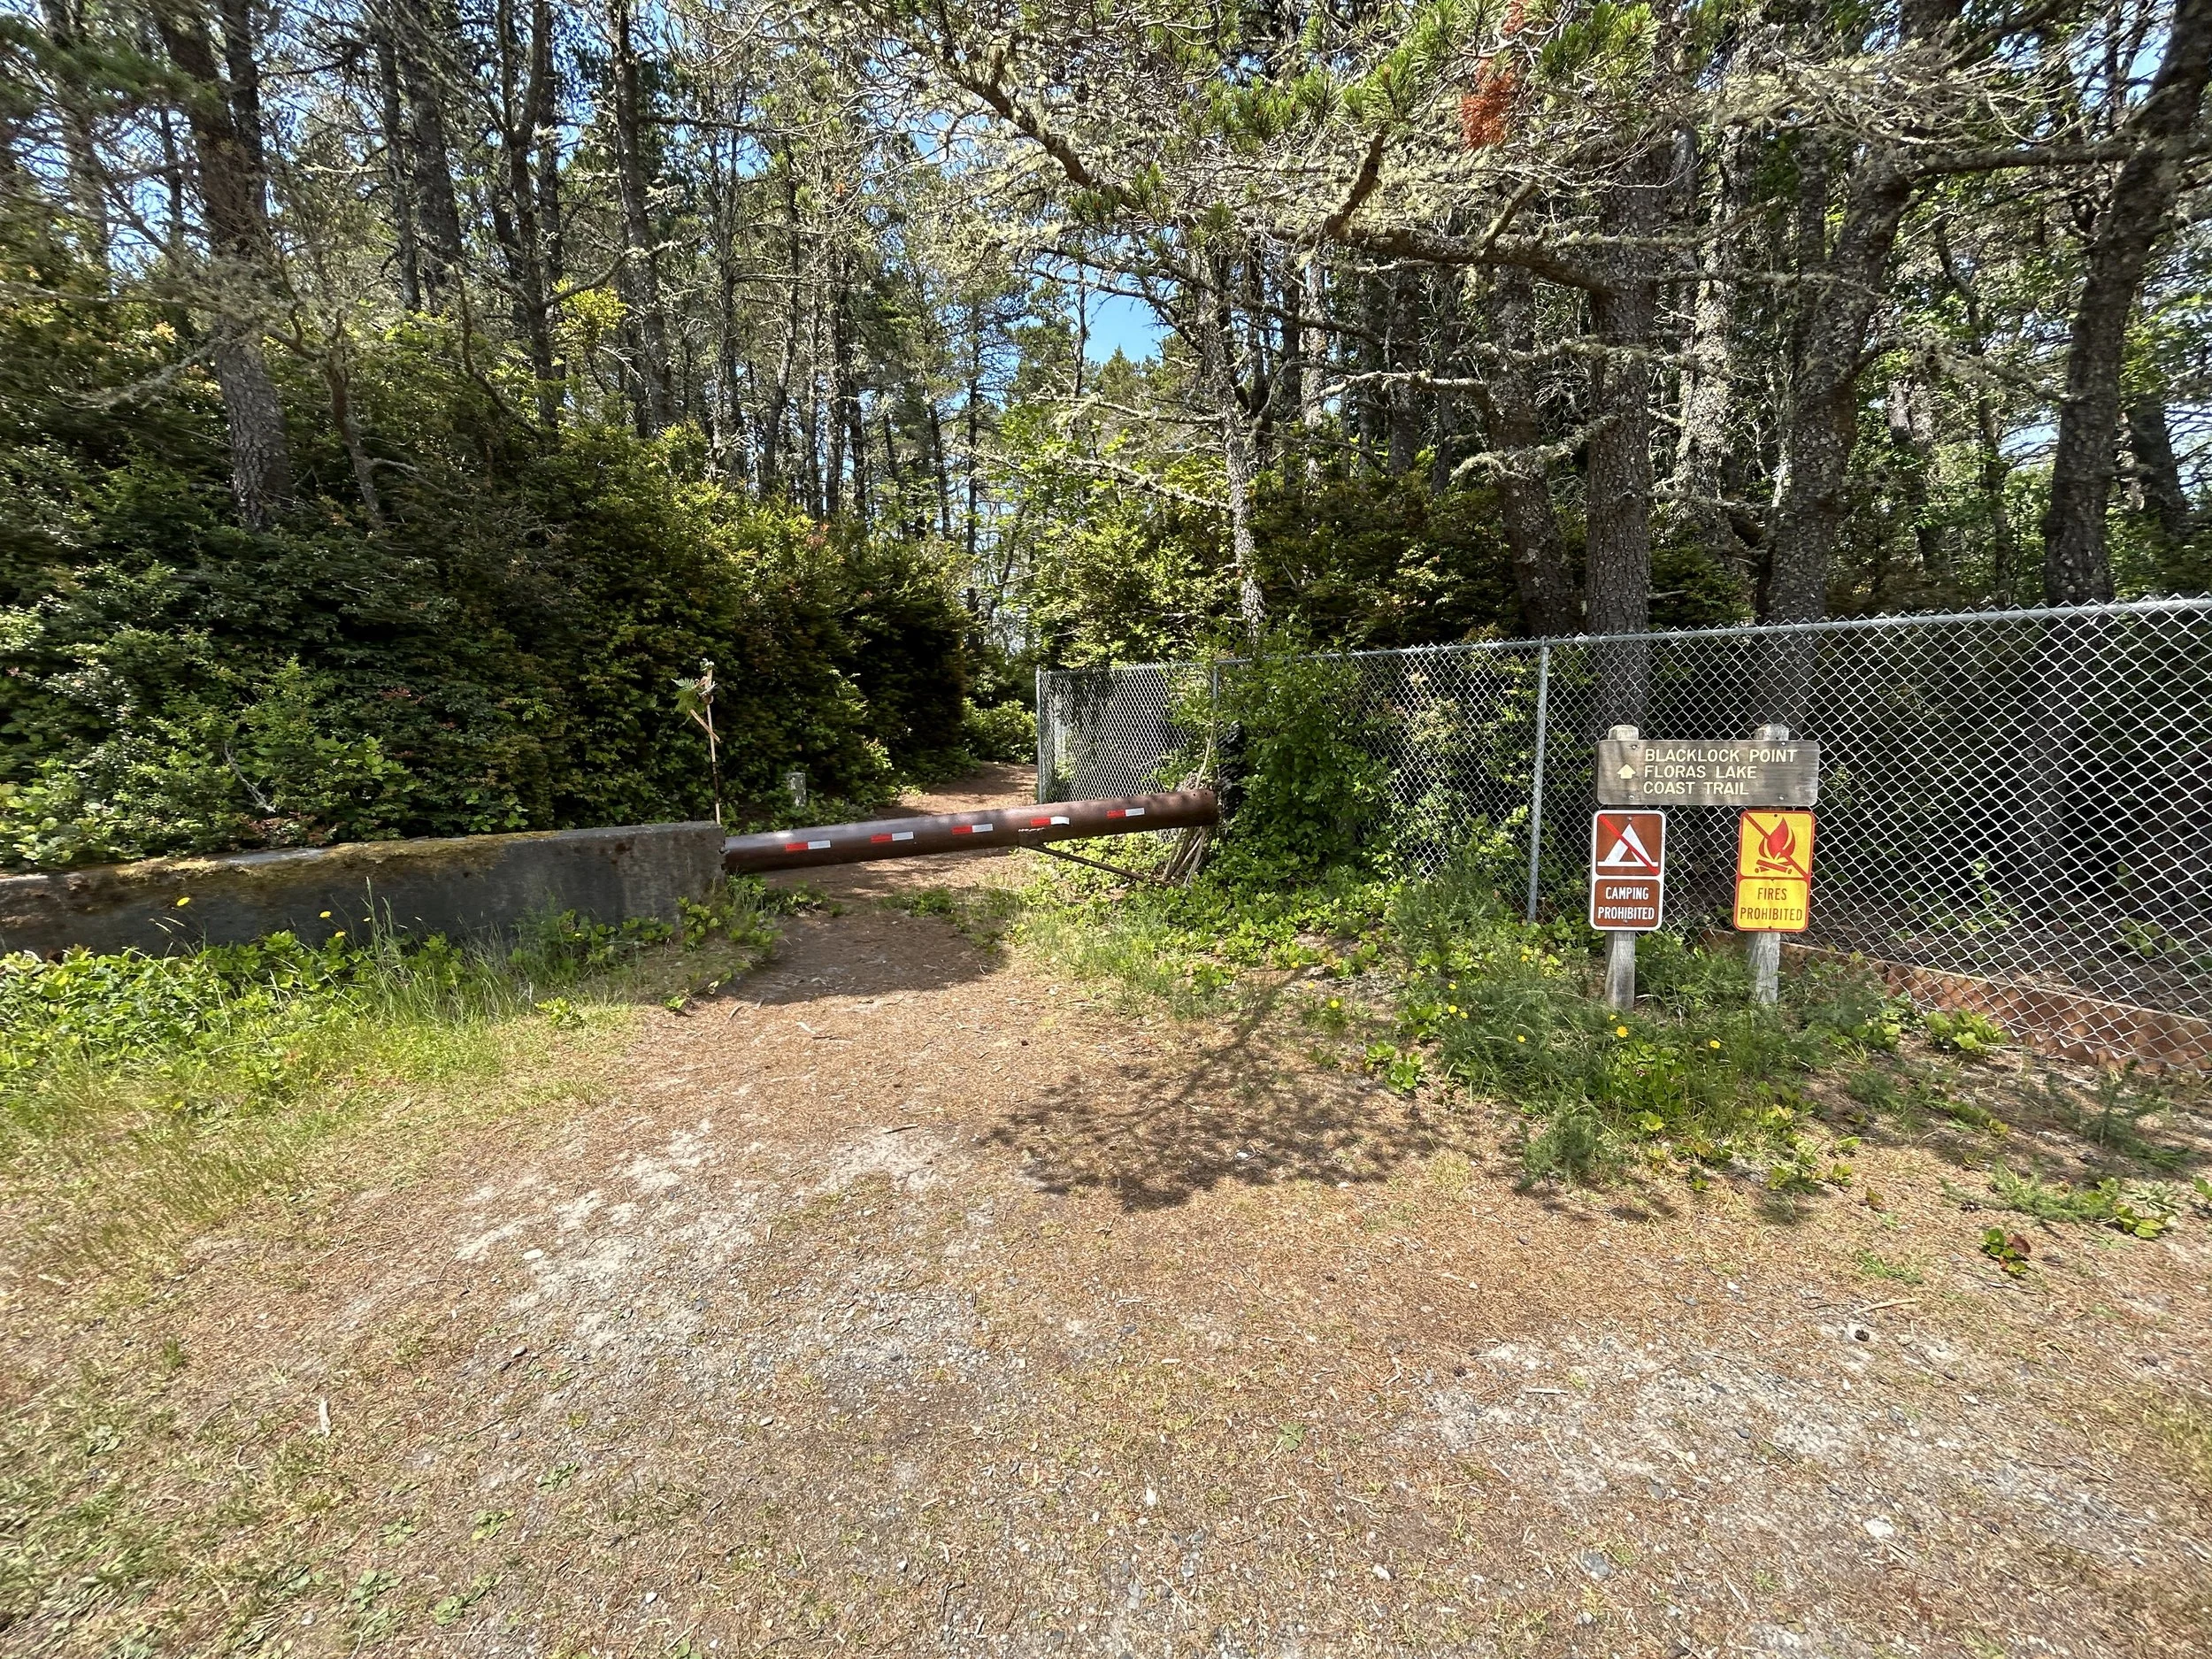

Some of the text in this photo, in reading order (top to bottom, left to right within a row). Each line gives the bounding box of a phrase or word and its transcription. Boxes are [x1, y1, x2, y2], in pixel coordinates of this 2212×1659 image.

[1644, 748, 1798, 763] BLACKLOCK POINT
[1644, 764, 1757, 780] FLORAS LAKE
[1643, 781, 1749, 795] COAST TRAIL
[1605, 887, 1649, 900] CAMPING
[1757, 887, 1787, 901] FIRES
[1597, 906, 1655, 920] PROHIBITED
[1740, 907, 1802, 921] PROHIBITED
